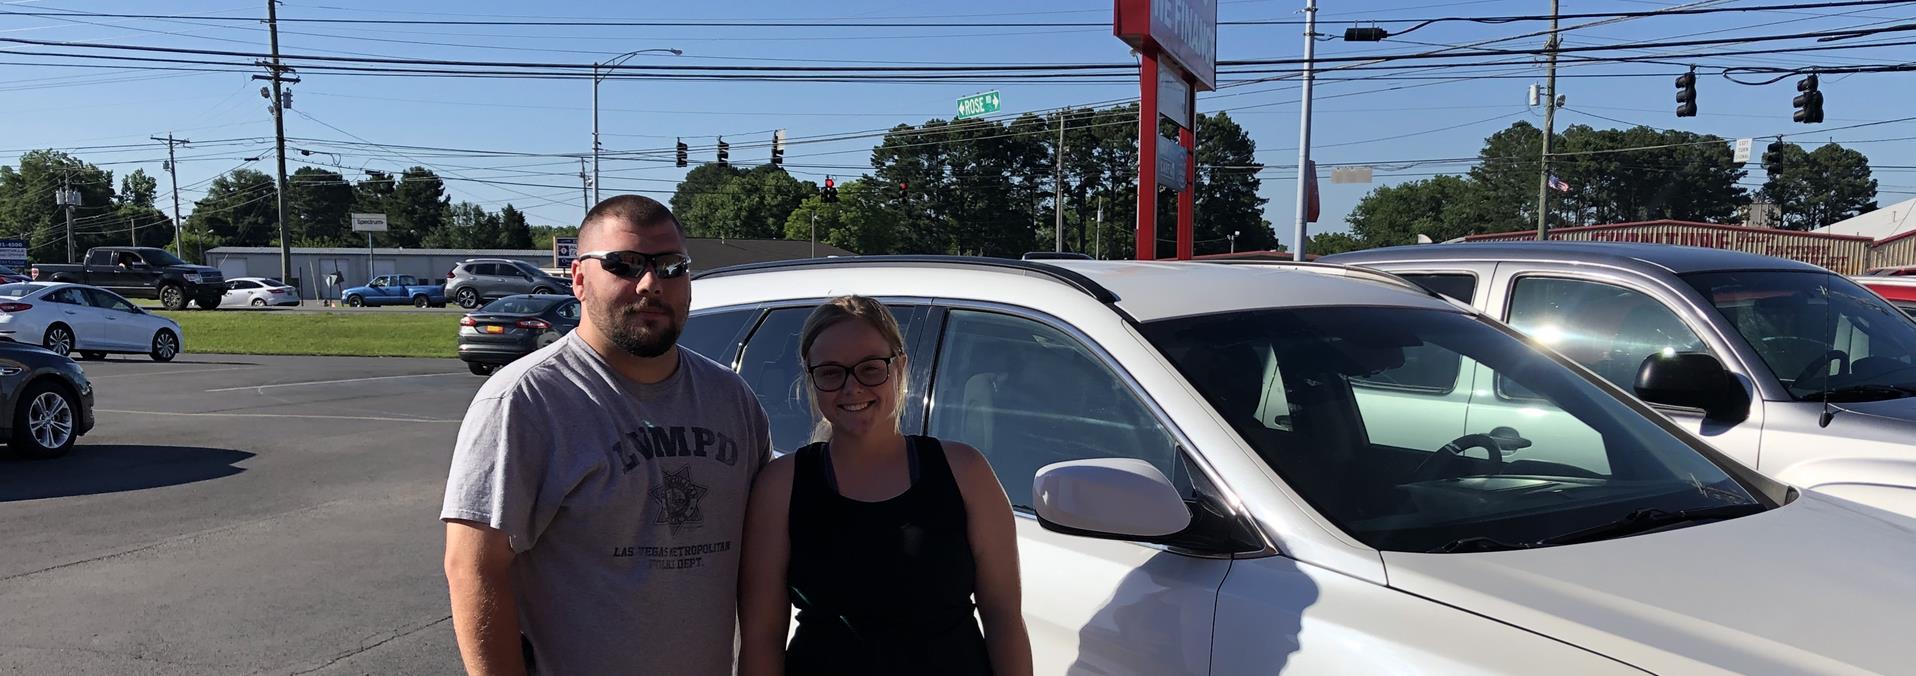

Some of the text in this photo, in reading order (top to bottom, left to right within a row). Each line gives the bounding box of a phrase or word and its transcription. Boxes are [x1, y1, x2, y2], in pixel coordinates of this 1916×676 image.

[964, 97, 984, 115] ROSE
[613, 426, 738, 475] LVMPD
[613, 546, 634, 557] LAS
